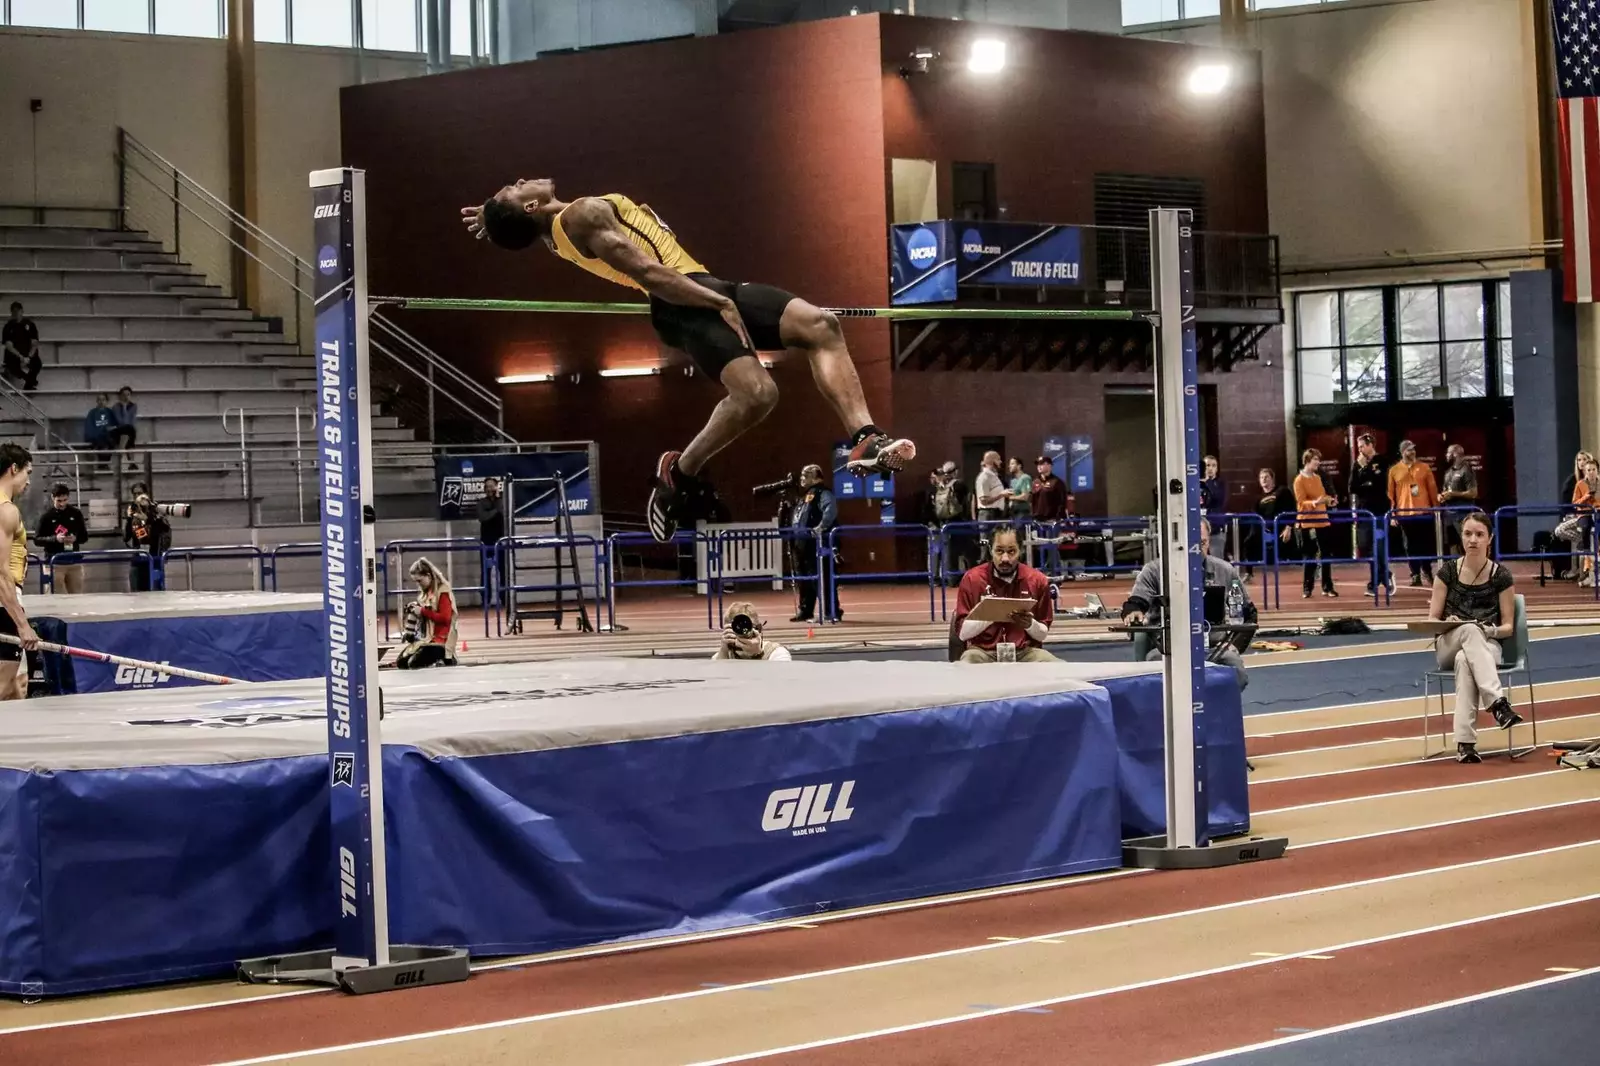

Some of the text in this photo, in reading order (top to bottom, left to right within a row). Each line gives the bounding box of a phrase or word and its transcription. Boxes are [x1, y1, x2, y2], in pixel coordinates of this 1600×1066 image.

[343, 190, 352, 203] 8
[314, 203, 341, 219] GILL
[1180, 226, 1192, 238] 8
[910, 246, 937, 260] NCAA
[963, 243, 1001, 255] NCAA.com
[320, 258, 338, 269] NCAA
[1011, 261, 1079, 279] TRACK & FIELD
[345, 287, 354, 301] 7
[1182, 305, 1194, 317] 7
[348, 386, 357, 400] 6
[1184, 384, 1197, 396] 6
[1186, 463, 1198, 476] 5
[350, 485, 360, 500] 5
[321, 340, 350, 739] TRACK & FIELD CHAMPIONSHIPS
[1188, 543, 1202, 555] 4
[353, 584, 363, 599] 4
[1191, 622, 1203, 634] 3
[357, 684, 366, 699] 3
[1192, 702, 1204, 713] 2
[360, 783, 369, 798] 2
[761, 780, 856, 832] GILL
[792, 828, 808, 837] MADE
[815, 826, 827, 834] USA
[339, 846, 357, 918] GILL
[394, 969, 425, 986] GILL
